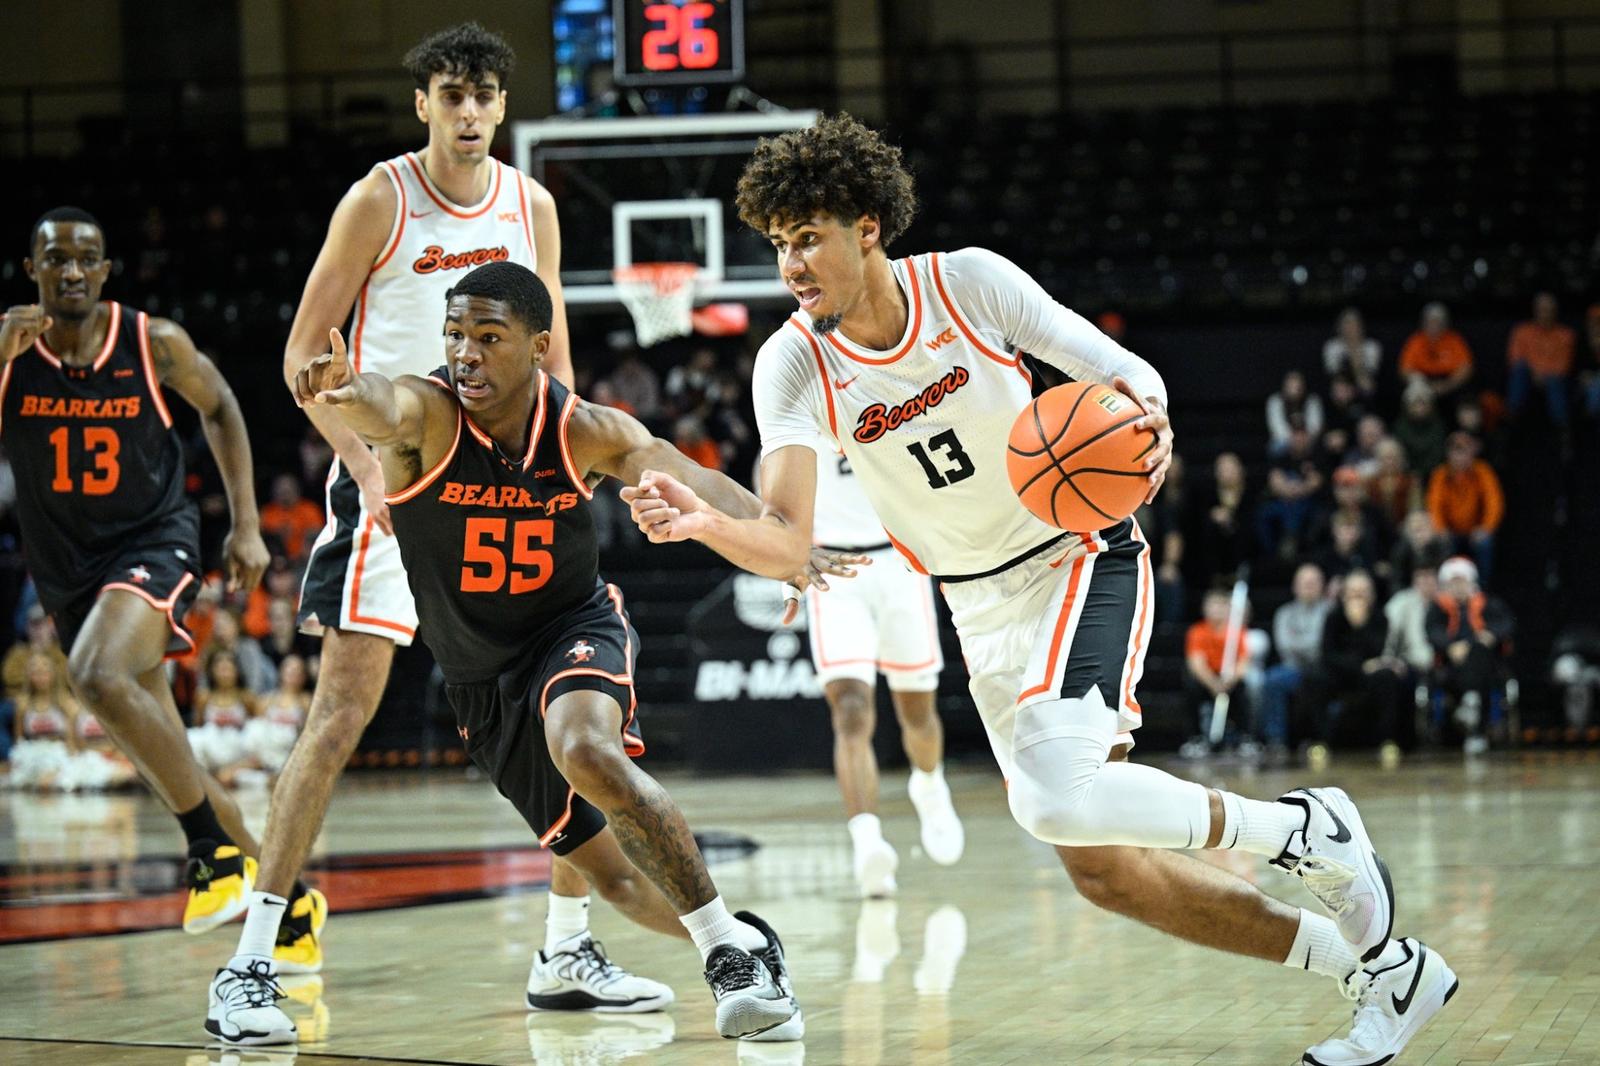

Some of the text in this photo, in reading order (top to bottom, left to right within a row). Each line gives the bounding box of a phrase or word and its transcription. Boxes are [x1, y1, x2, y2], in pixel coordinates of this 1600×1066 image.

[642, 3, 719, 70] 26
[413, 245, 509, 274] Beavers
[20, 395, 141, 418] BEARKATS
[853, 366, 969, 443] Beavers
[49, 426, 120, 495] 13
[906, 428, 975, 489] 13
[460, 517, 554, 595] 55
